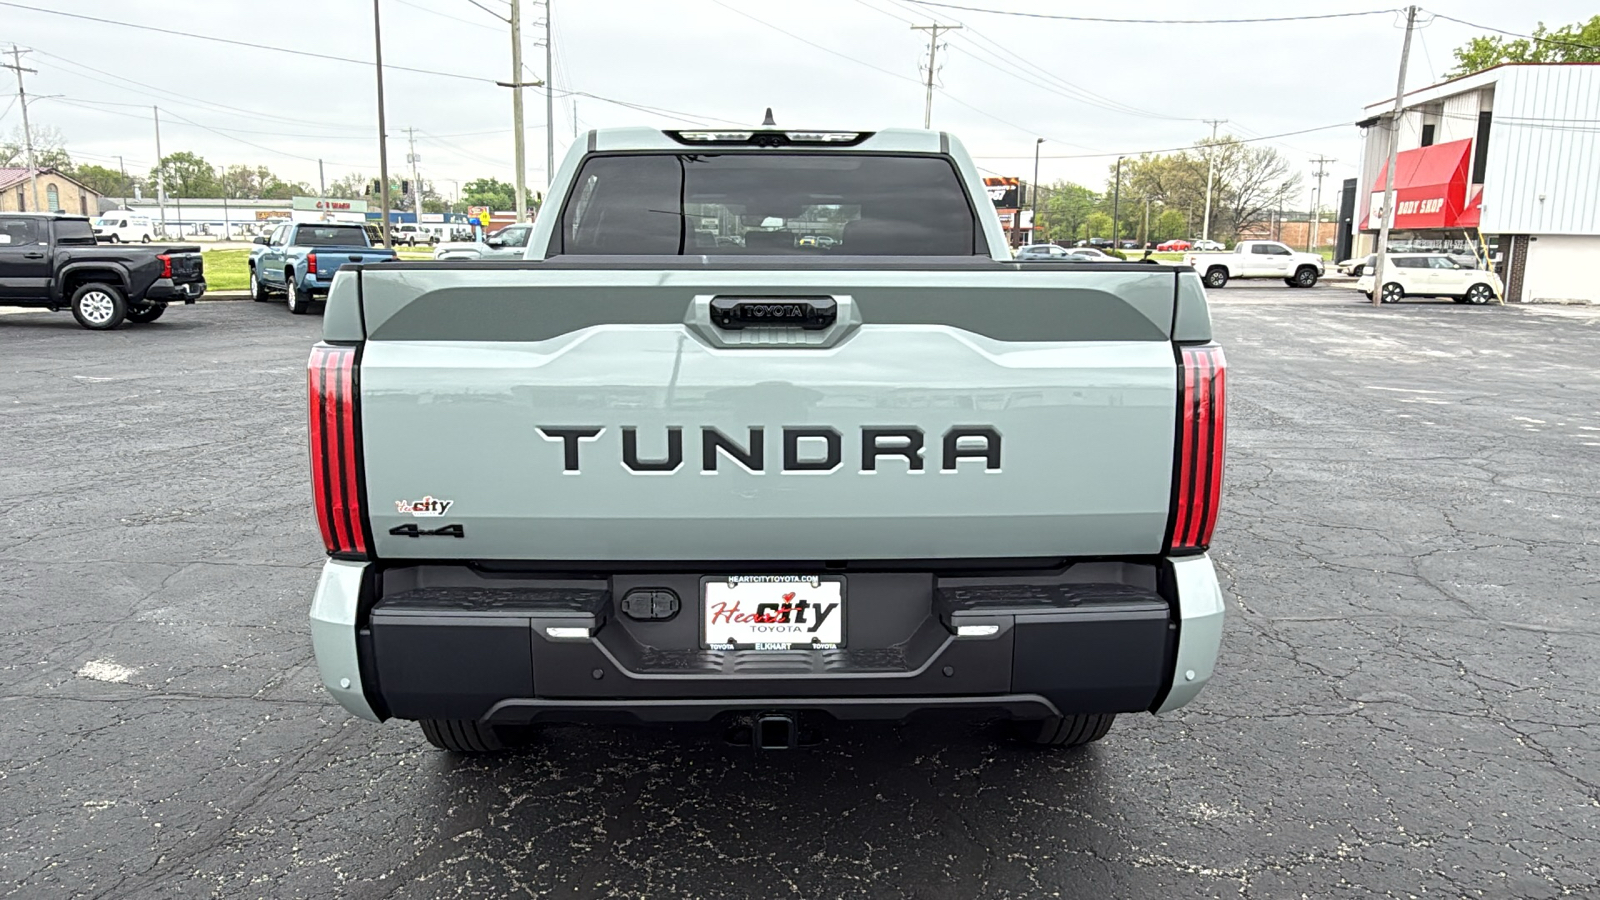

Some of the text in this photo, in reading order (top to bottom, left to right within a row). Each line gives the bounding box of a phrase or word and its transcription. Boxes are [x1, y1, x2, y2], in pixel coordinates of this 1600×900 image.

[316, 201, 351, 210] CR WASH
[1397, 200, 1420, 215] BODY
[1420, 198, 1444, 214] SHOP
[745, 305, 802, 317] TOYOTA
[535, 425, 1004, 476] TUNDRA
[711, 592, 839, 633] Heart city
[749, 625, 802, 633] TOYOTA
[755, 643, 792, 651] ELKHART
